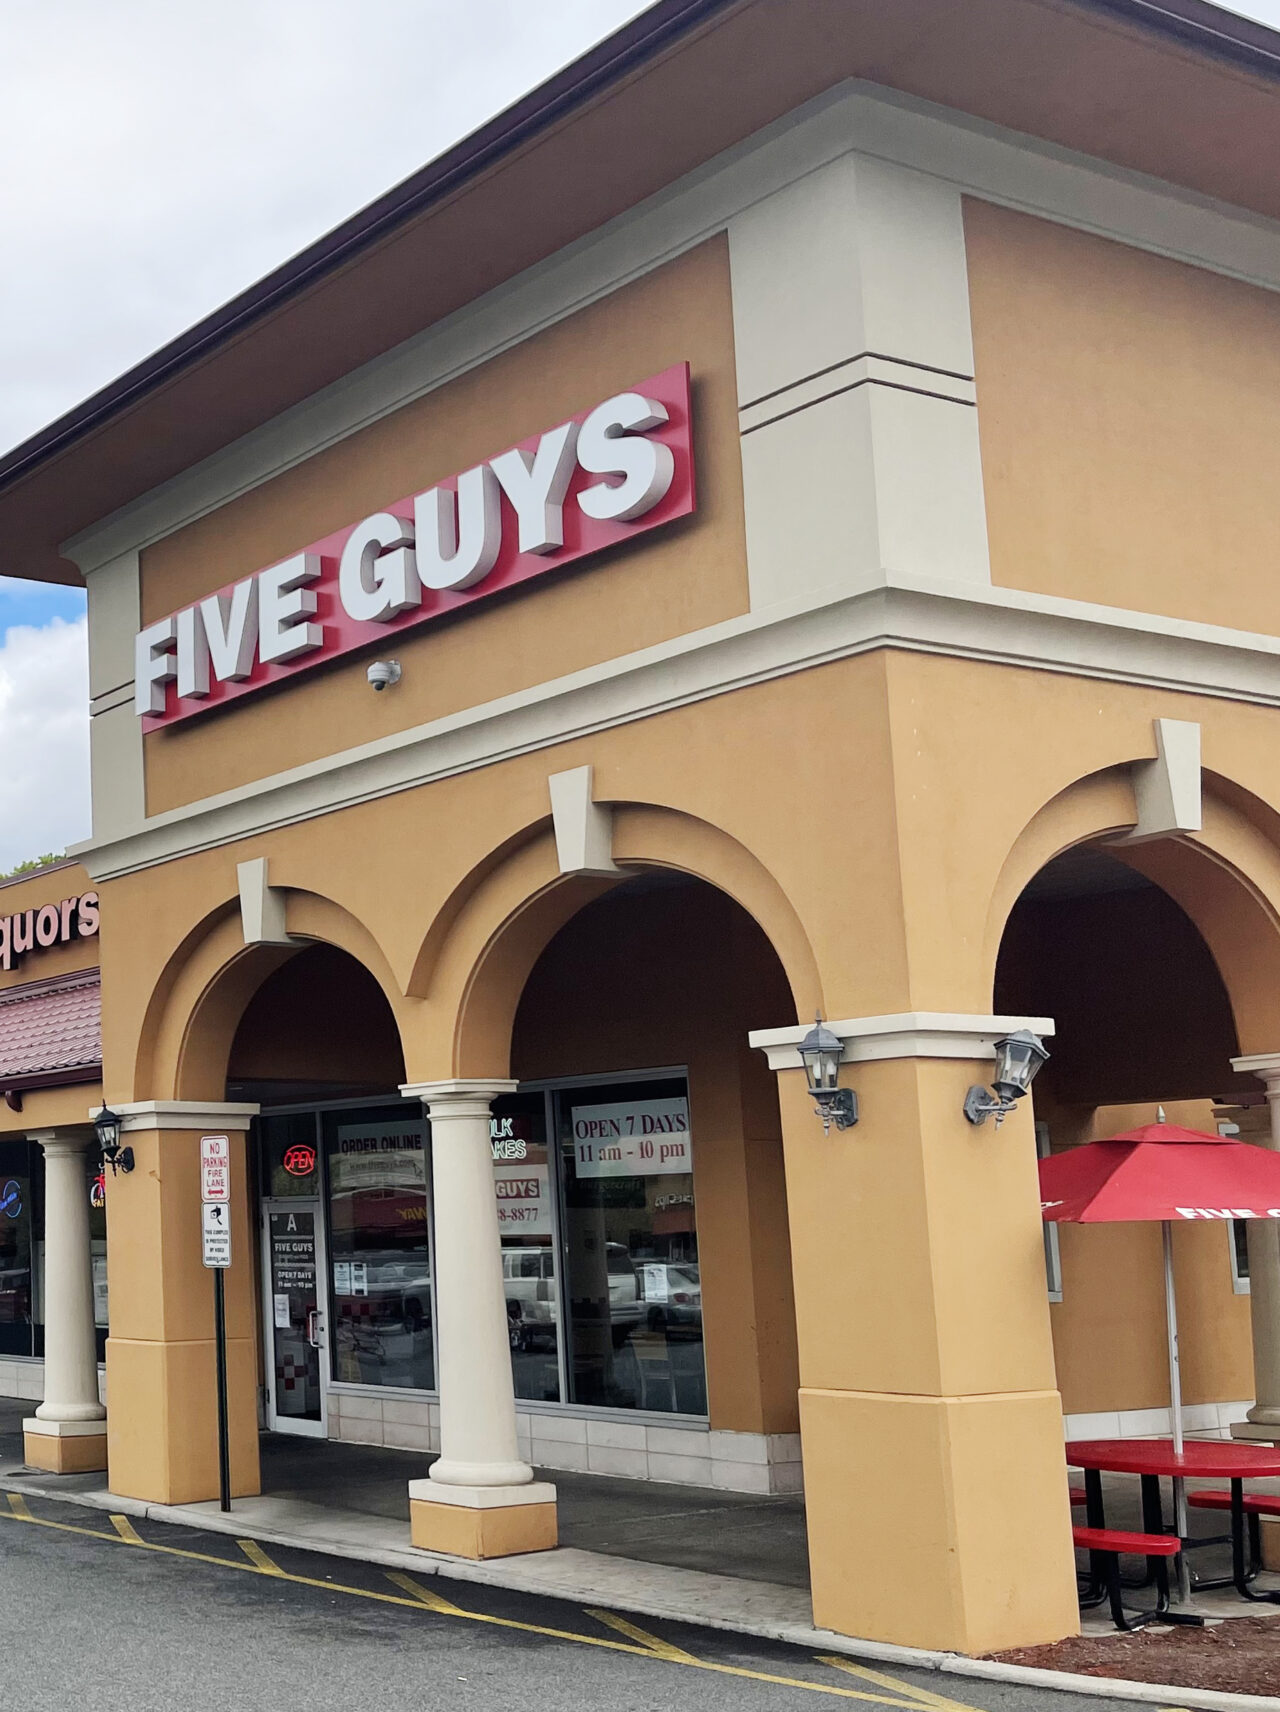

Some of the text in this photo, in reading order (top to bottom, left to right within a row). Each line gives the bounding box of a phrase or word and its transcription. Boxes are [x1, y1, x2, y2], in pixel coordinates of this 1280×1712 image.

[135, 392, 674, 717] FIVE GUYS
[575, 1113, 687, 1140] OPEN 7 DAYS
[209, 1142, 220, 1155] NO
[341, 1134, 422, 1154] ORDER ONLINE
[579, 1144, 594, 1162] 11
[599, 1146, 622, 1161] am
[639, 1140, 654, 1159] 10
[659, 1143, 685, 1163] pm
[203, 1155, 228, 1168] PARKING
[284, 1150, 315, 1169] OPEN
[207, 1169, 223, 1178] FIRE
[206, 1179, 225, 1187] LANE
[496, 1181, 539, 1197] GUYS
[497, 1207, 539, 1222] 8-8877
[1175, 1207, 1261, 1219] FIVE
[287, 1213, 297, 1232] A
[274, 1242, 313, 1252] FIVE GUYS
[277, 1271, 293, 1279] OPEN
[297, 1271, 312, 1279] DAYS
